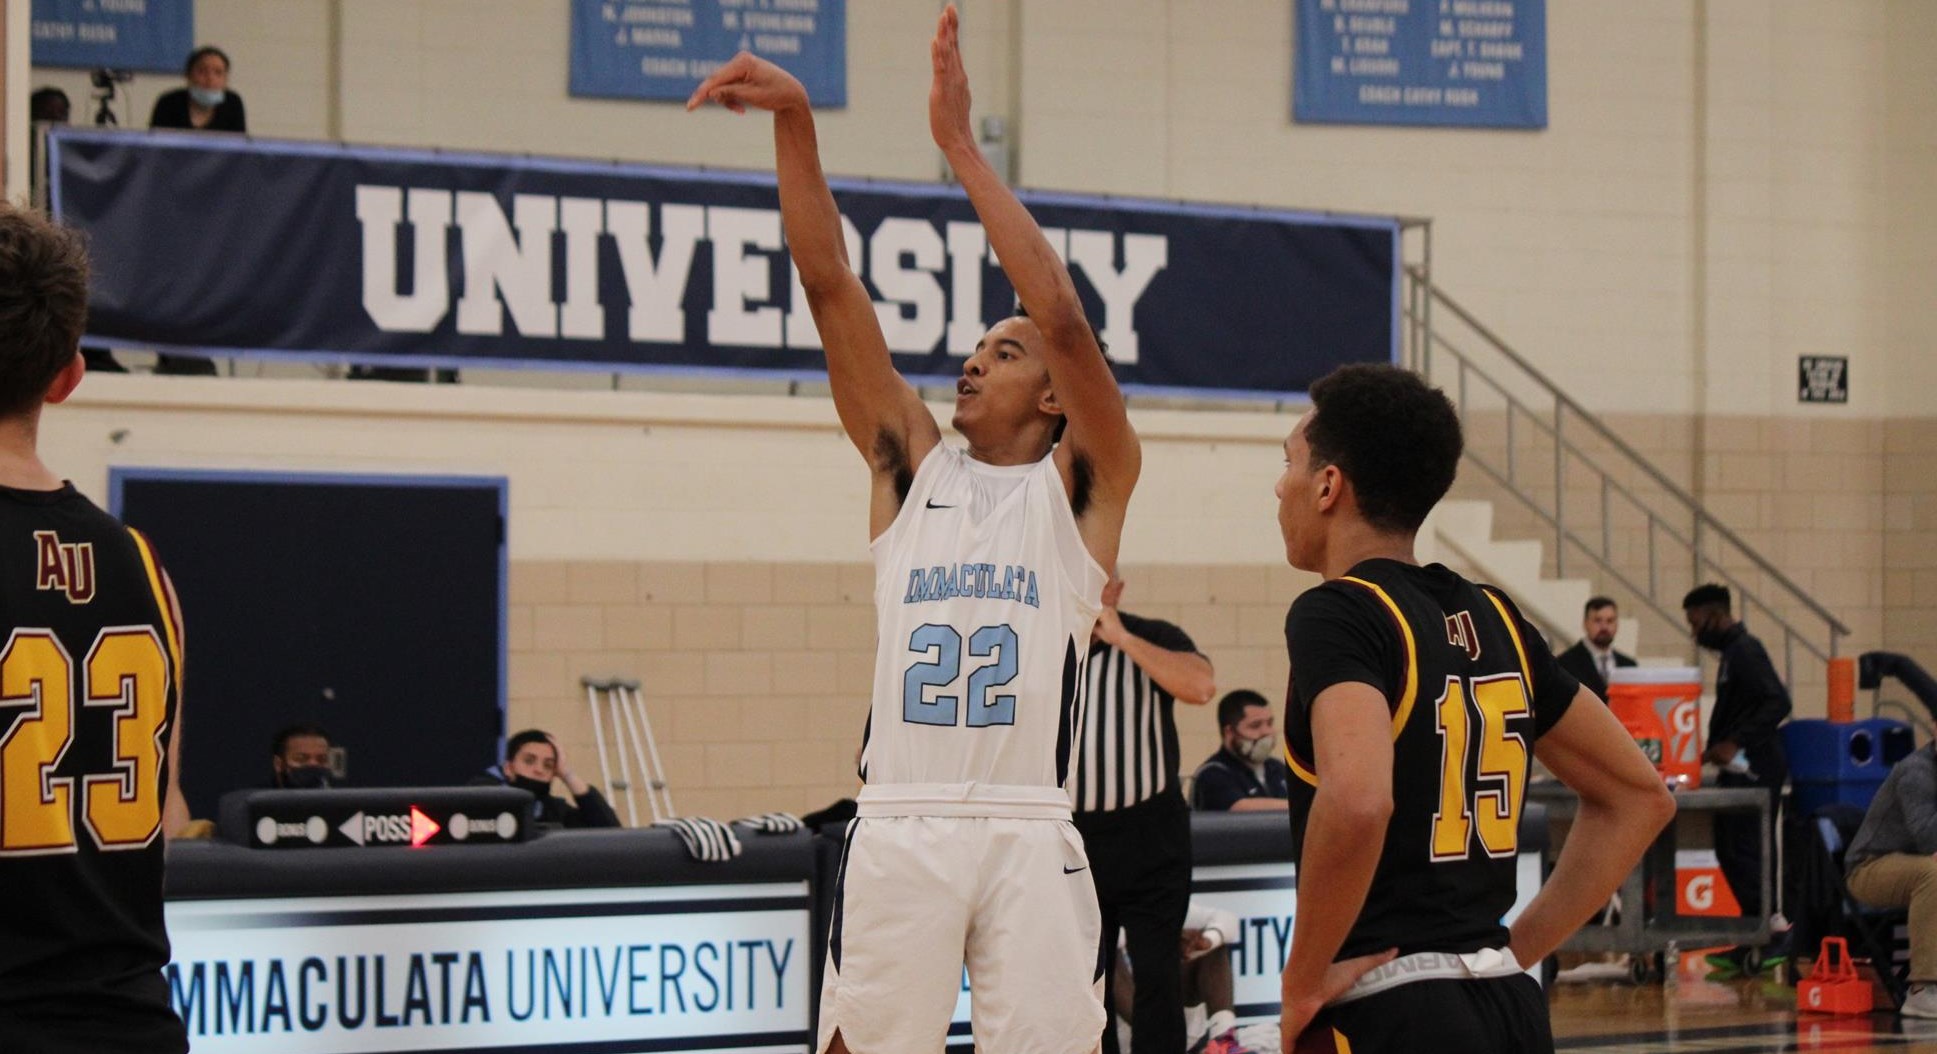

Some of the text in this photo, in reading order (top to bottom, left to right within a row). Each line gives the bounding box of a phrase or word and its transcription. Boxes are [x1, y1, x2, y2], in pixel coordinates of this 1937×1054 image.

[356, 184, 1168, 364] UNIVESIY
[33, 530, 95, 604] AU
[903, 562, 1040, 609] IMMACULATA
[903, 623, 1019, 727] 22
[0, 624, 170, 857] 23
[1430, 672, 1530, 863] 15
[364, 814, 412, 842] POSS
[1685, 875, 1715, 911] G
[167, 938, 793, 1036] MMACULATA UNIVERSITY
[1808, 986, 1822, 1008] G
